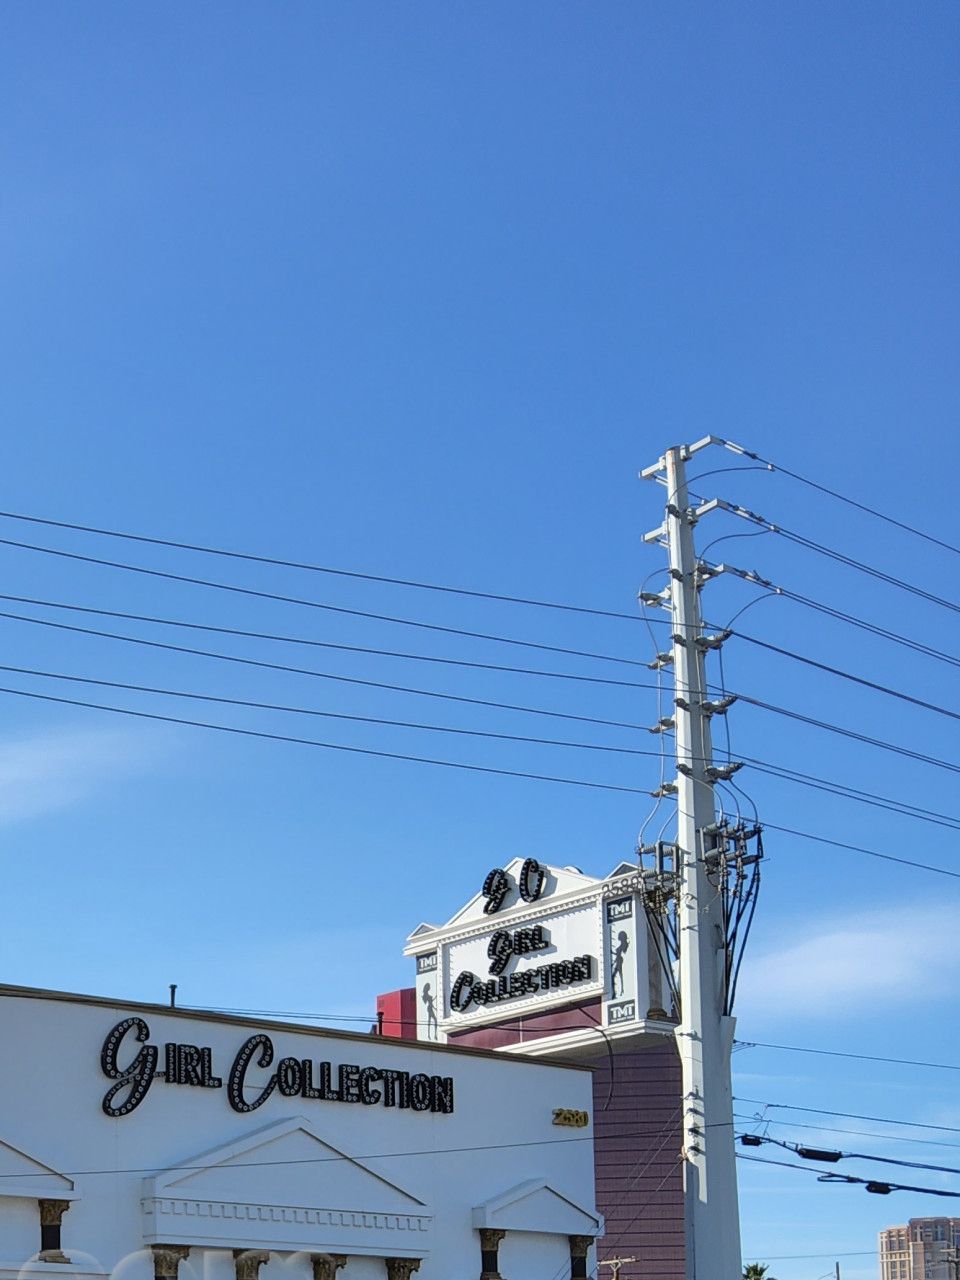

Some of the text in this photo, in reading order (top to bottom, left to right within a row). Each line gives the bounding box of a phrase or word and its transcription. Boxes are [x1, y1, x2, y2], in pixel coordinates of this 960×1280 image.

[607, 901, 631, 916] TMT
[450, 954, 591, 1012] COLLECTION
[610, 1003, 635, 1019] TMT
[101, 1017, 454, 1117] GIRL COLLECTION
